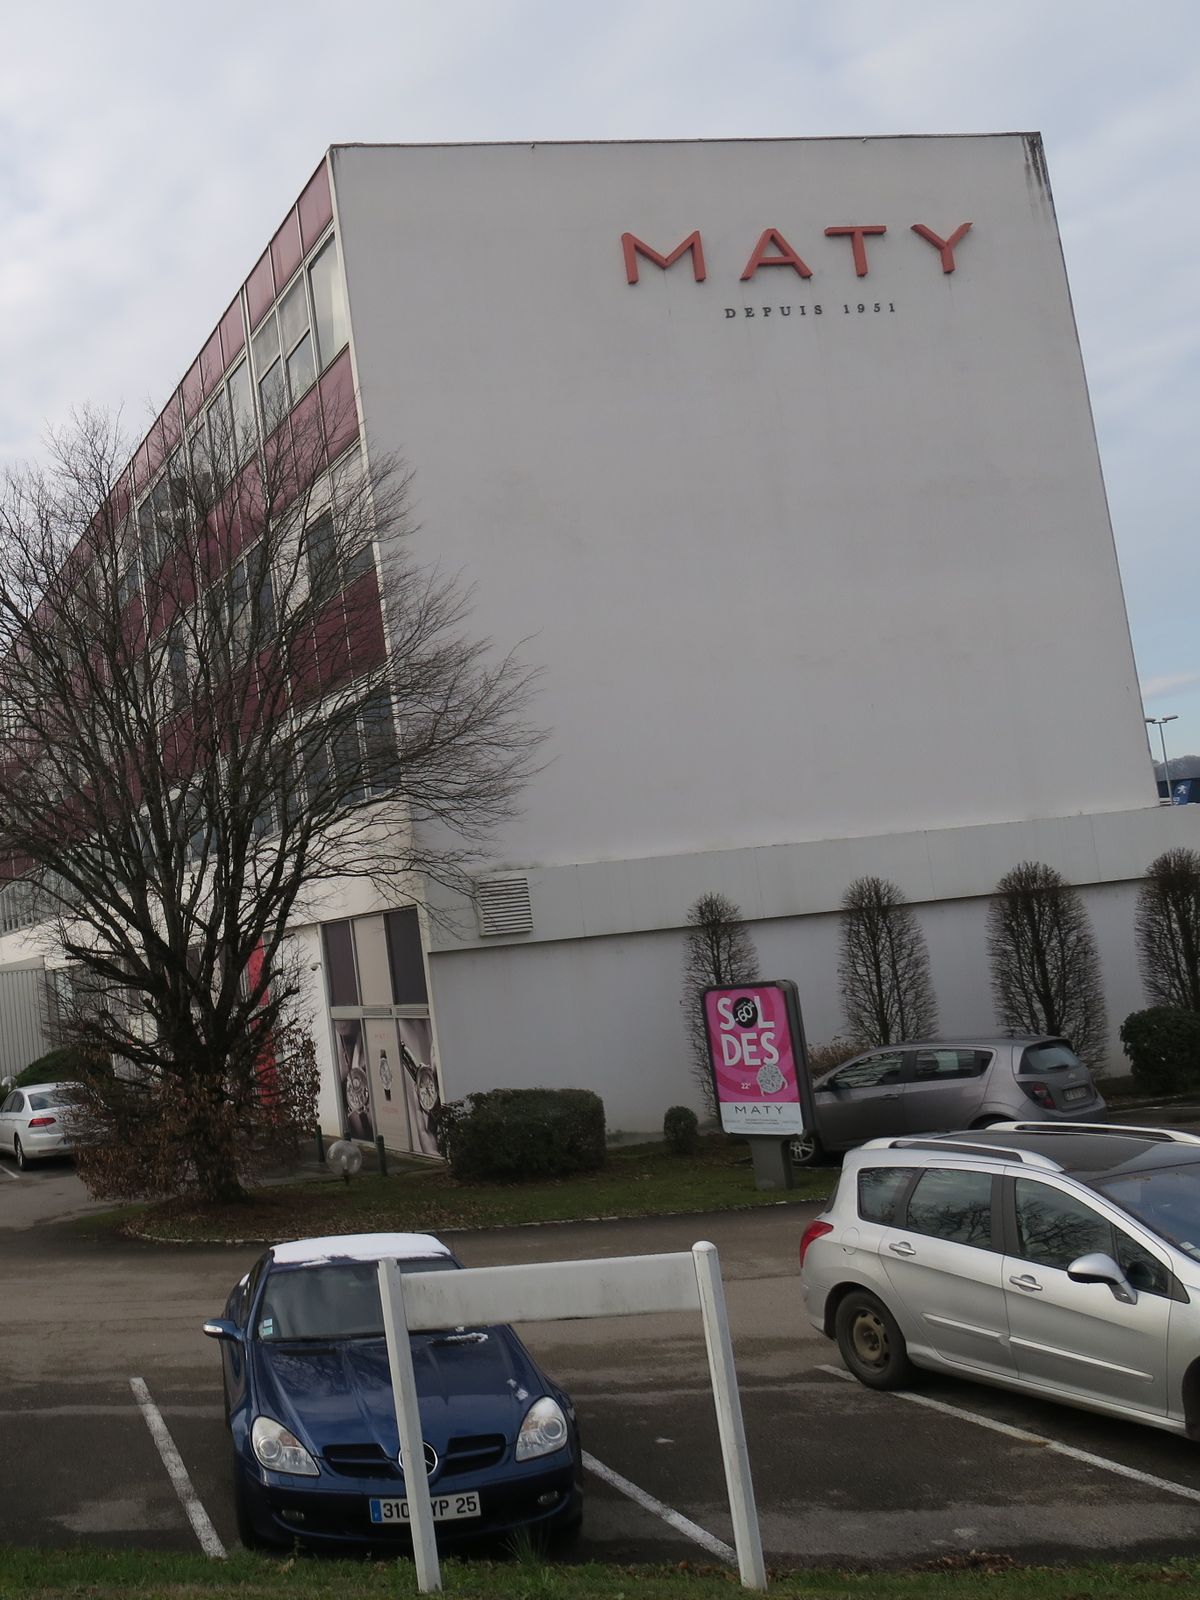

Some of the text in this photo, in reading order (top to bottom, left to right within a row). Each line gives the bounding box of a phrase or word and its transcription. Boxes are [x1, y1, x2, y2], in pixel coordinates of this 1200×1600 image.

[621, 222, 973, 284] MATY
[725, 303, 896, 318] DEPUIS 1951
[720, 1032, 779, 1066] DES
[735, 1105, 783, 1115] MATY
[383, 1503, 410, 1518] 310
[456, 1496, 477, 1513] 25
